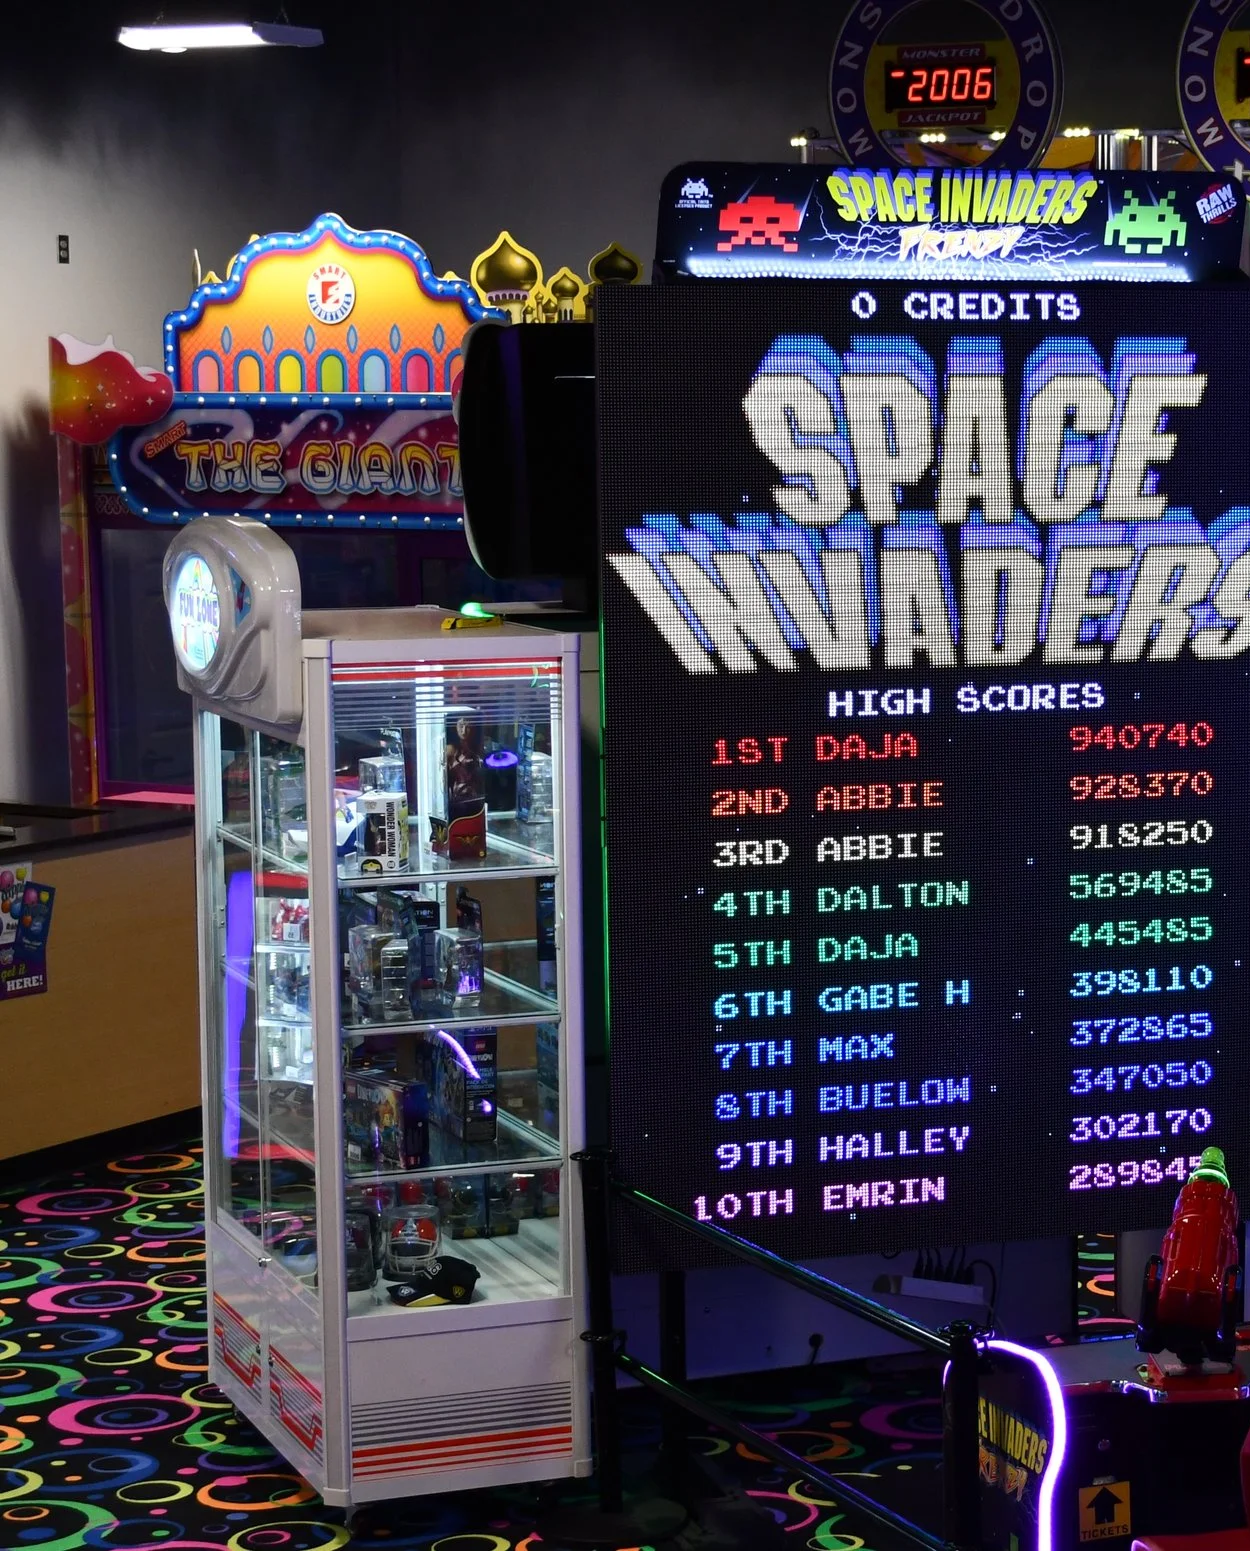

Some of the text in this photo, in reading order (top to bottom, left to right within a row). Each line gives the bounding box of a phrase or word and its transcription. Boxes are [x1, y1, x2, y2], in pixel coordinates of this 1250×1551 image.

[902, 48, 981, 60] MONSTER
[902, 111, 981, 124] JACKPOT
[826, 172, 1098, 225] SPACE INVADERS
[1196, 184, 1233, 215] RAW
[1200, 197, 1238, 224] THRILLS
[899, 223, 1026, 262] FRENZY
[313, 265, 346, 280] SMART
[308, 294, 352, 321] INDUSTRIES
[904, 292, 1081, 321] CREDITS
[144, 421, 187, 458] SMART
[742, 360, 1208, 525] SPACE
[175, 440, 465, 497] THE GIANT
[828, 685, 1105, 717] HIGH SCORES
[713, 722, 1213, 765] 1ST DAJA 940740
[713, 771, 1213, 816] 2ND ABBIE 928370
[386, 801, 396, 858] WONDER WOMAN
[713, 819, 1213, 867] 3RD ABBIE 918250
[713, 868, 1213, 917] 4TH DALTON 569485
[713, 916, 1213, 968] 5TH DAJA 445485
[7, 974, 44, 993] HERE!
[714, 964, 1213, 1019] 6TH GABE H 398110
[714, 1012, 1213, 1070] 7TH MAX 372865
[715, 1060, 1213, 1120] 8TH BUELOW 347050
[716, 1108, 1213, 1170] 9TH HALLEY 302170
[694, 1188, 794, 1222] 10TH
[823, 1176, 945, 1212] EMRIN
[1081, 1525, 1129, 1540] TICKETS
